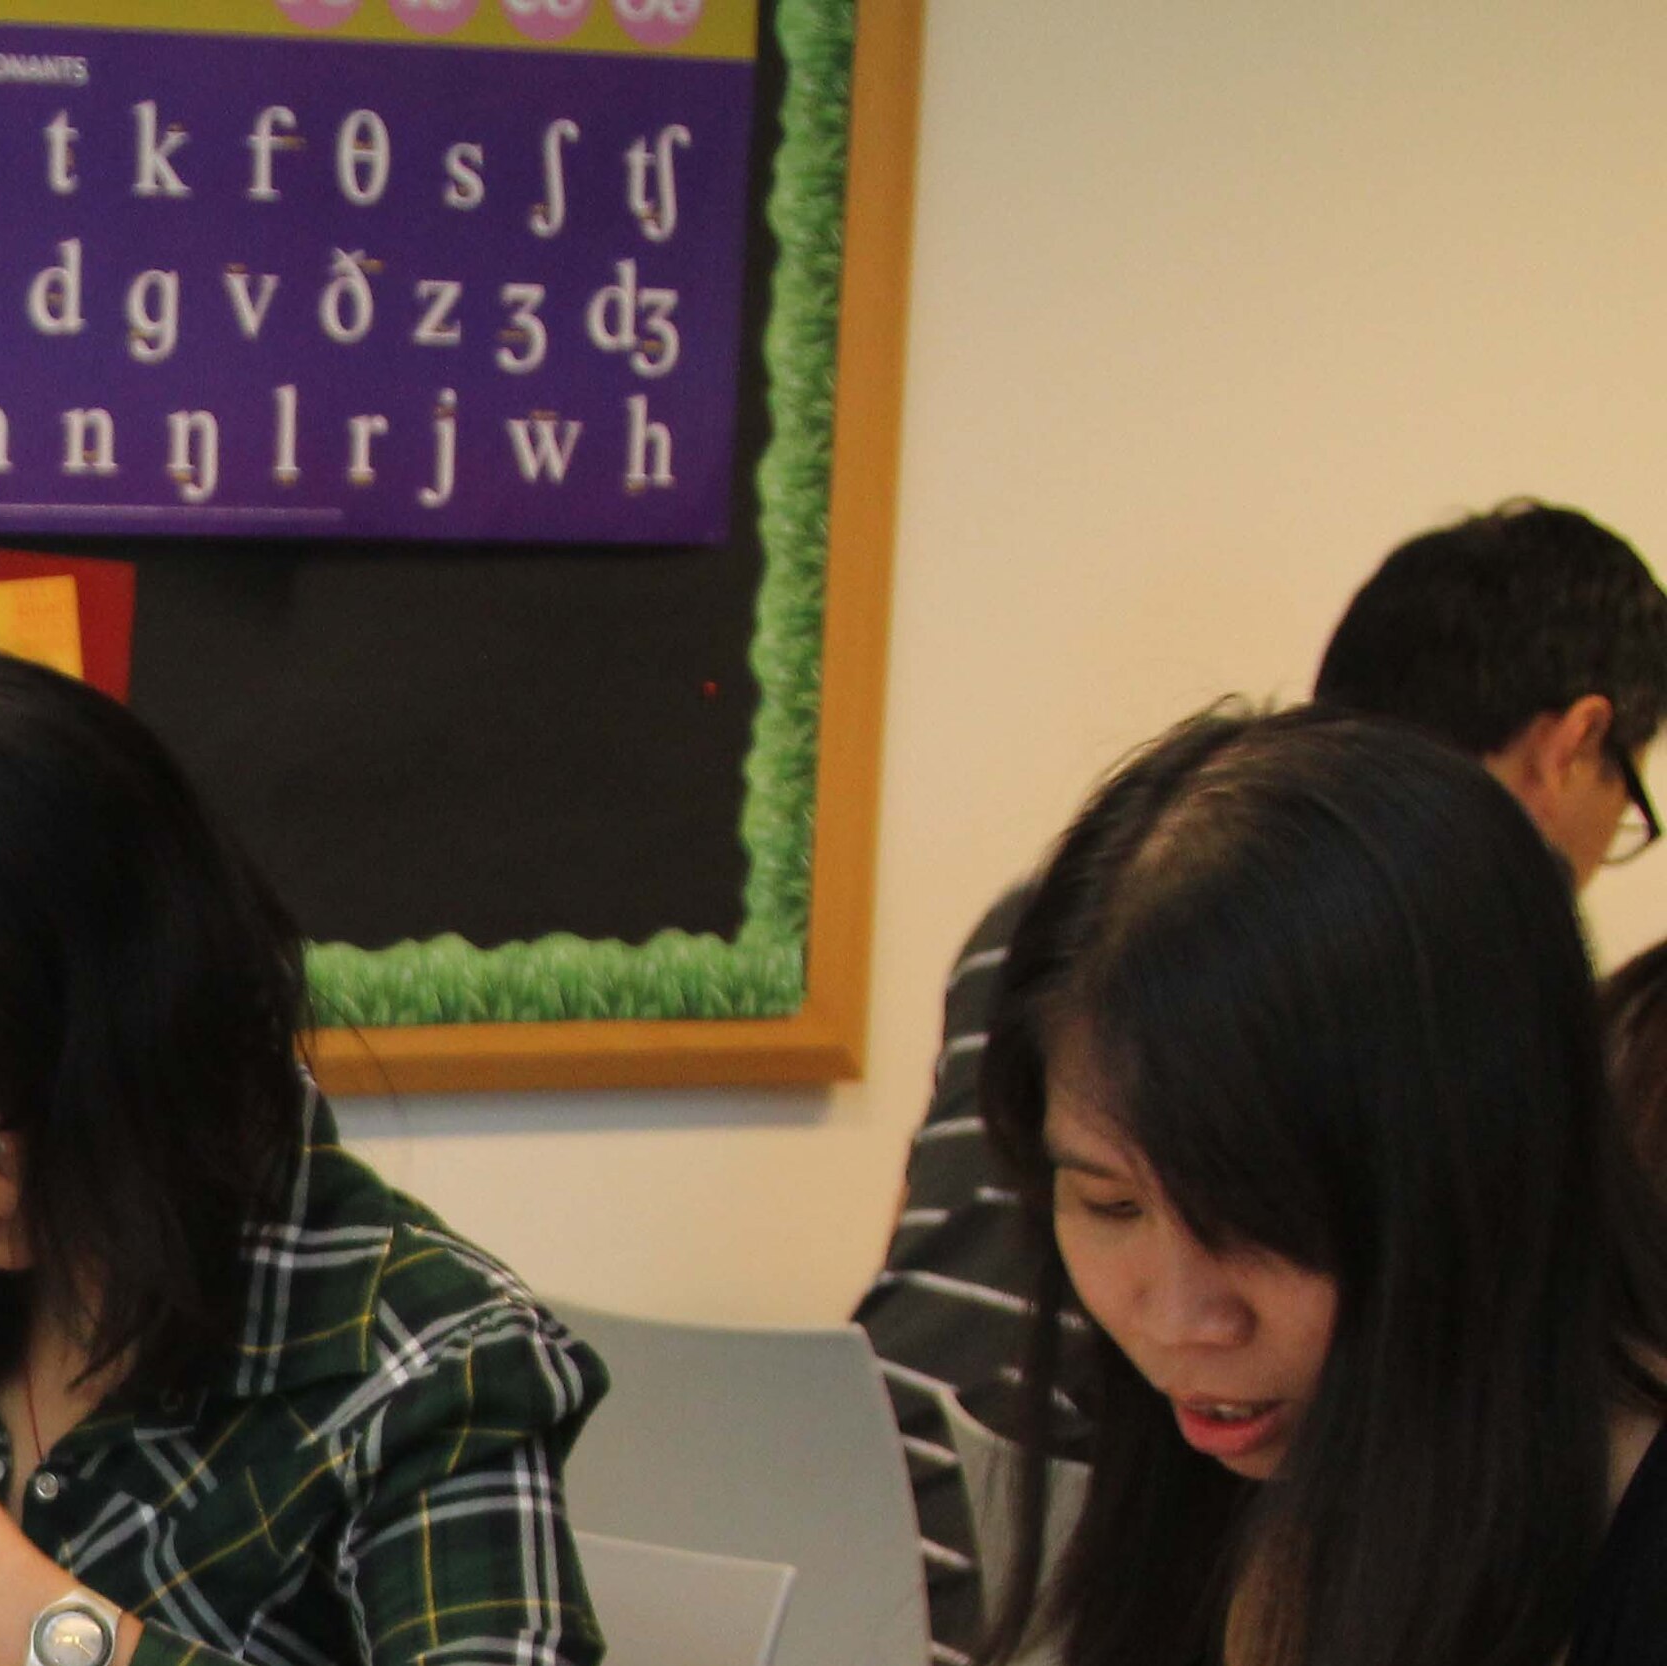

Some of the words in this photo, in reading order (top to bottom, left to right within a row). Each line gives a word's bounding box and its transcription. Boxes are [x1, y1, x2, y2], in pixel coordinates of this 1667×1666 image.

[47, 111, 78, 193] t
[133, 101, 189, 196] k
[249, 106, 296, 199] f
[337, 110, 390, 205] θ
[444, 140, 485, 210] s
[530, 118, 578, 236] ʃ
[27, 239, 85, 335] d
[128, 267, 179, 364] g
[225, 272, 278, 340] v
[319, 248, 375, 343] ð
[415, 279, 462, 345] z
[497, 283, 547, 372] ʒ
[62, 407, 116, 475] n
[168, 408, 218, 501] ŋ
[275, 387, 298, 482] l
[348, 413, 387, 483] r
[418, 390, 456, 507] j
[508, 419, 581, 482] w
[624, 397, 674, 491] h
